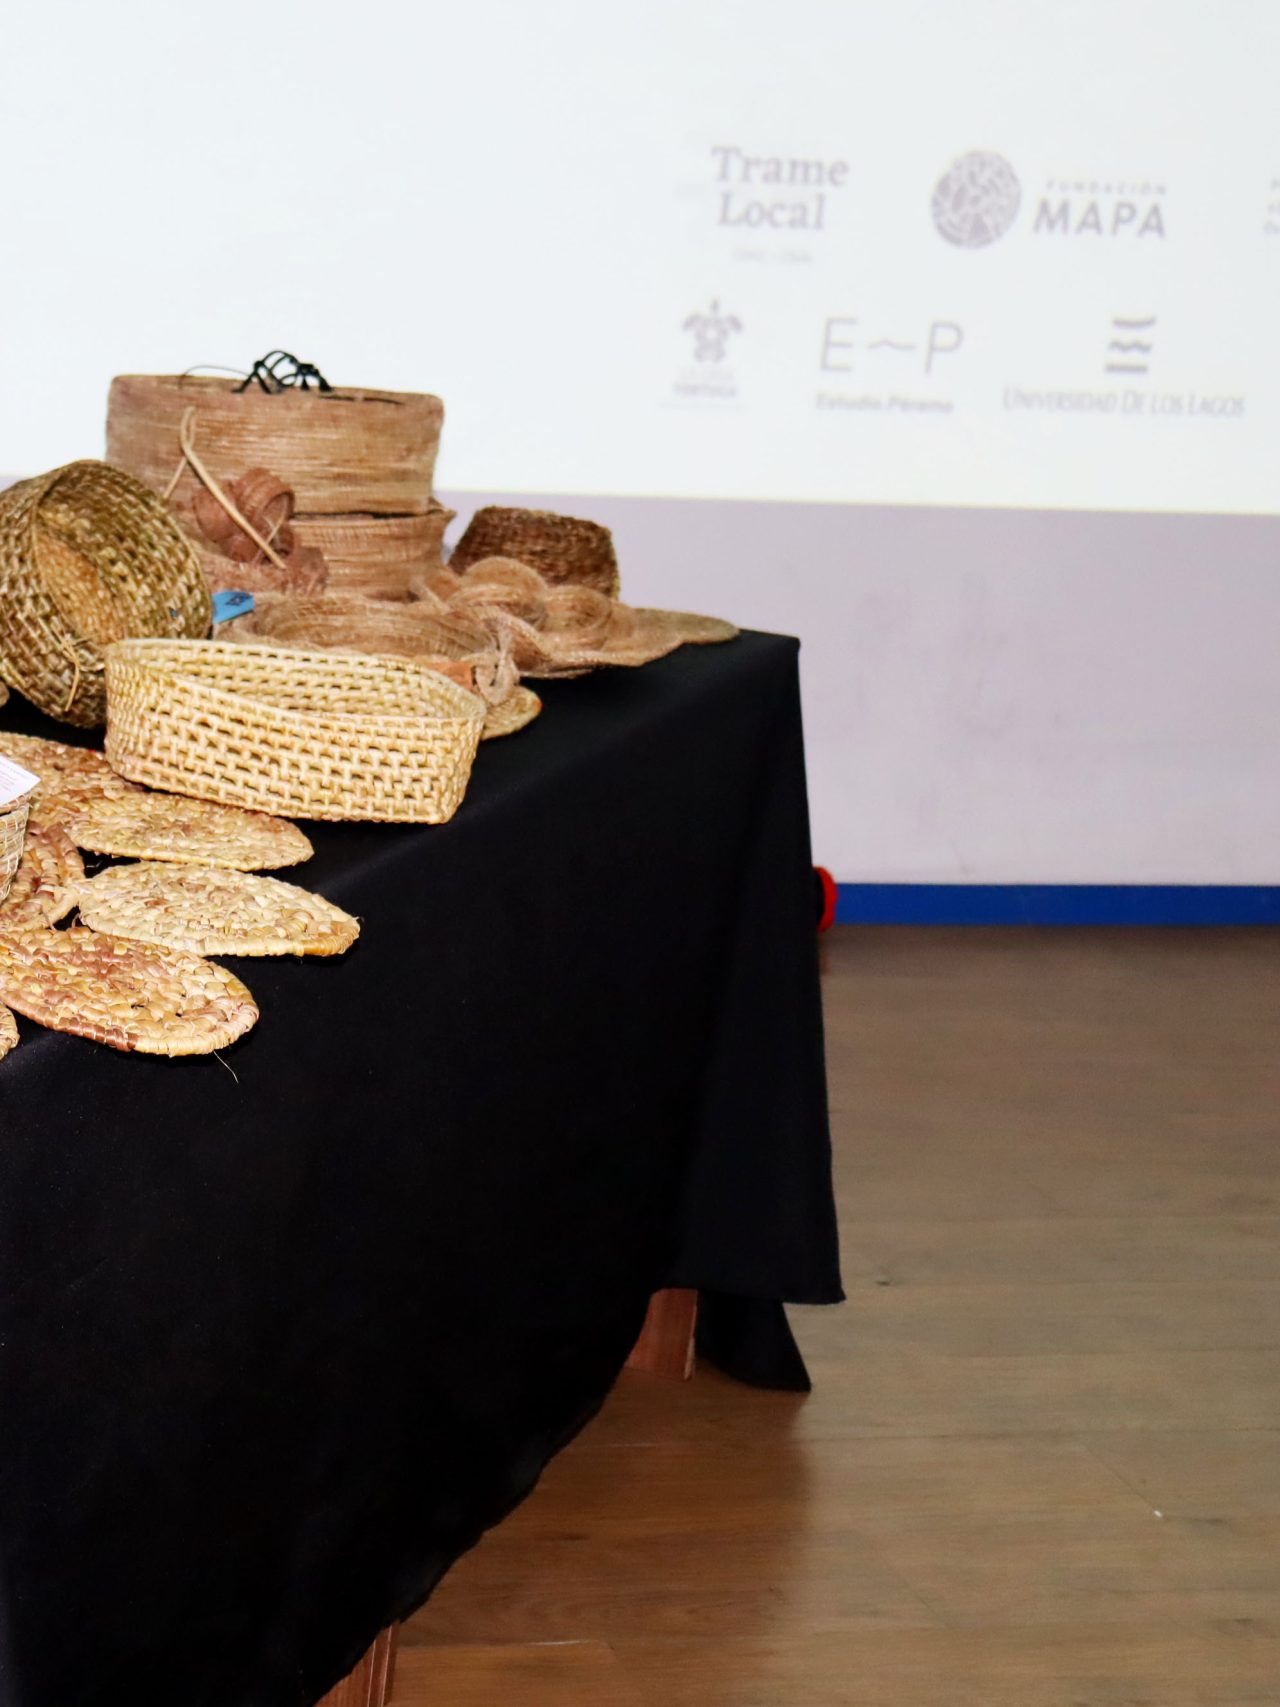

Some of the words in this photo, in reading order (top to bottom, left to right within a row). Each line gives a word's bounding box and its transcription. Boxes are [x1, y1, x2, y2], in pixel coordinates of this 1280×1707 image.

[709, 144, 851, 188] Trame
[717, 191, 827, 231] Local
[1032, 198, 1167, 239] MAPA
